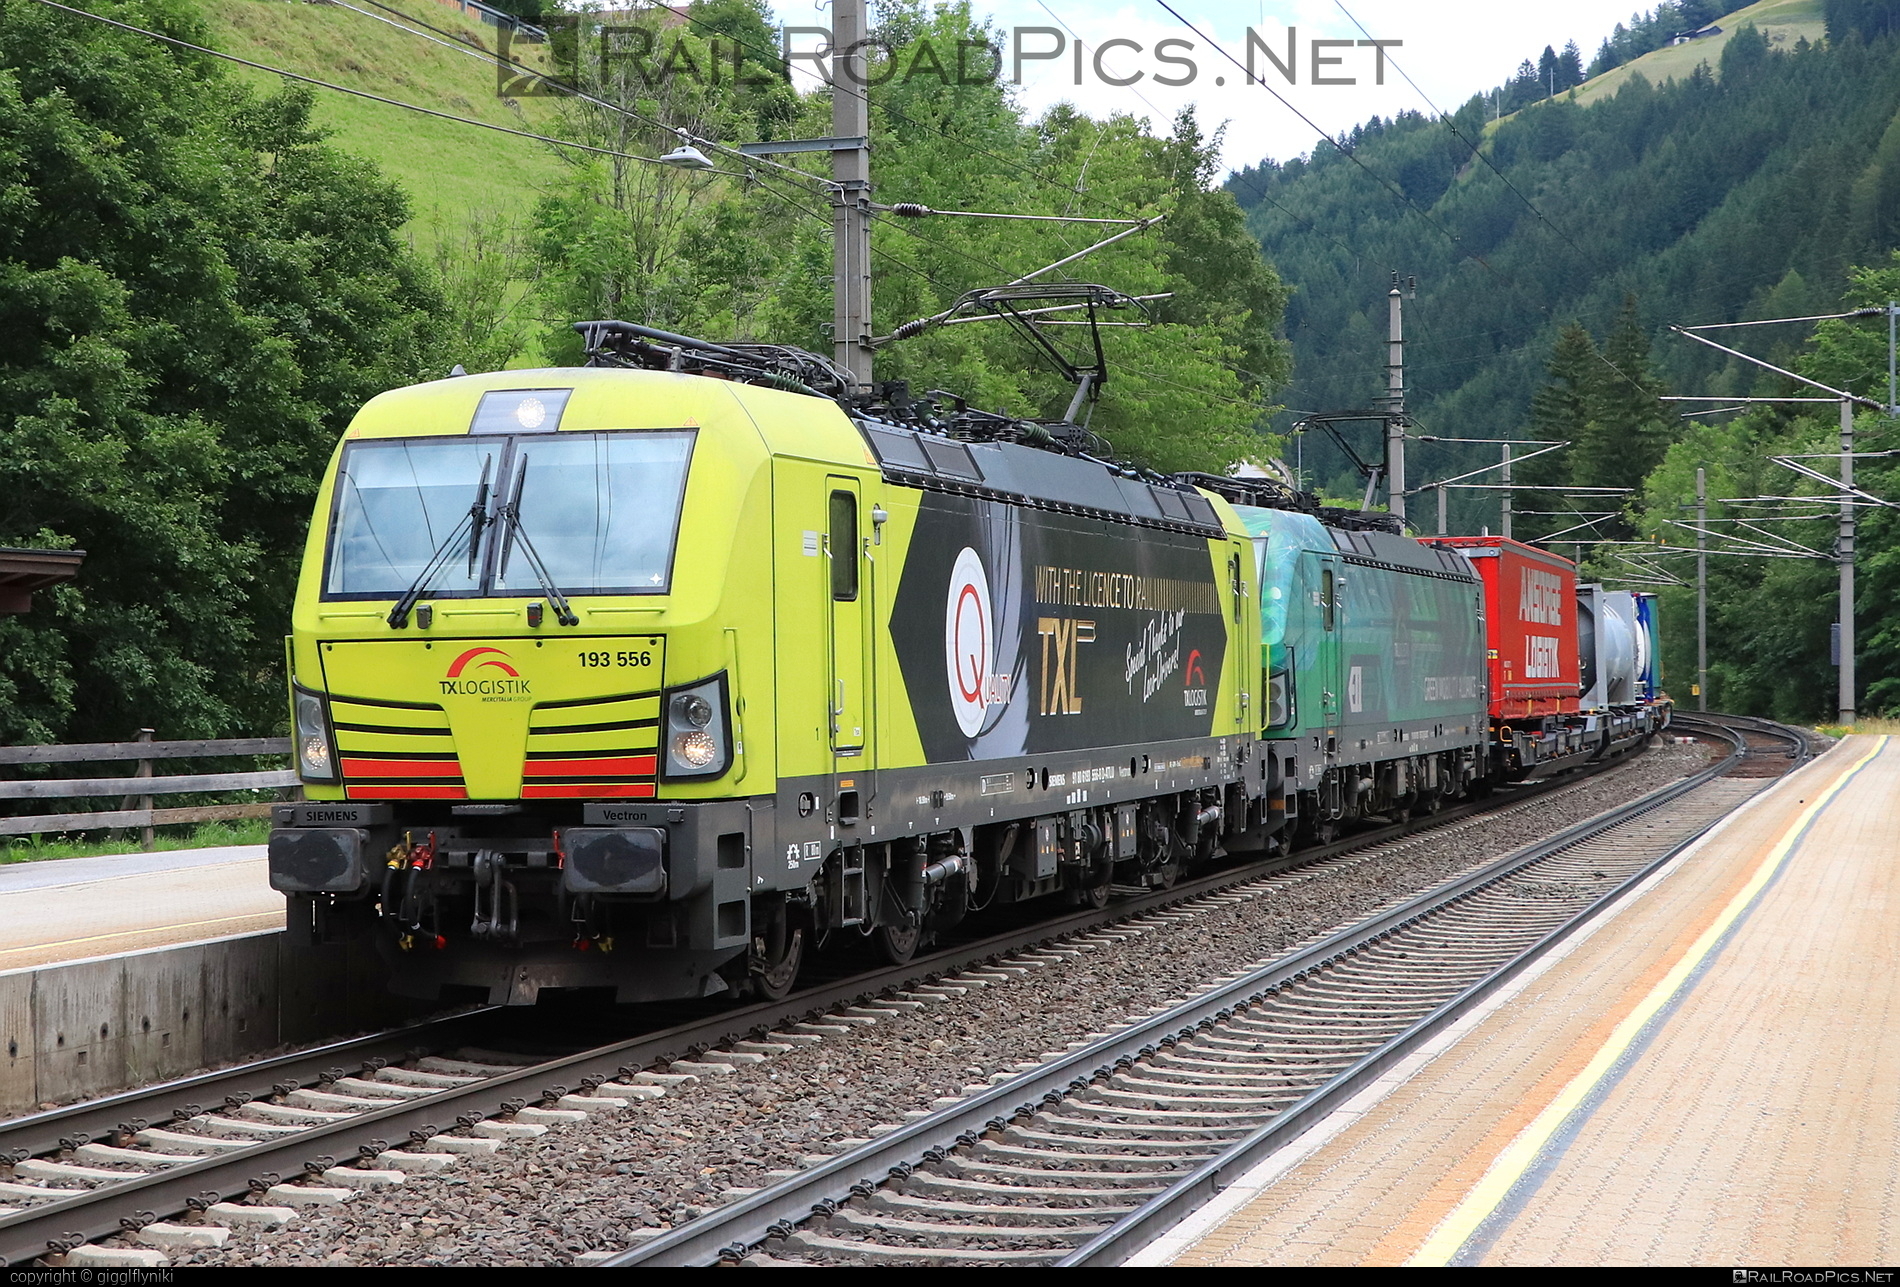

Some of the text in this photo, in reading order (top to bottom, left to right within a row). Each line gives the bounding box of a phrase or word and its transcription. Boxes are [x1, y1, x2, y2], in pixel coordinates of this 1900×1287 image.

[1035, 565, 1061, 604] WITH
[1064, 568, 1082, 606] THE
[1084, 570, 1121, 608] LICENCE
[1122, 574, 1135, 610] TO
[578, 650, 651, 668] 193 556
[1125, 627, 1147, 695] Special
[439, 679, 531, 695] TXLOGISTIK
[306, 810, 358, 822] SIEMENS
[603, 809, 647, 821] Vectron
